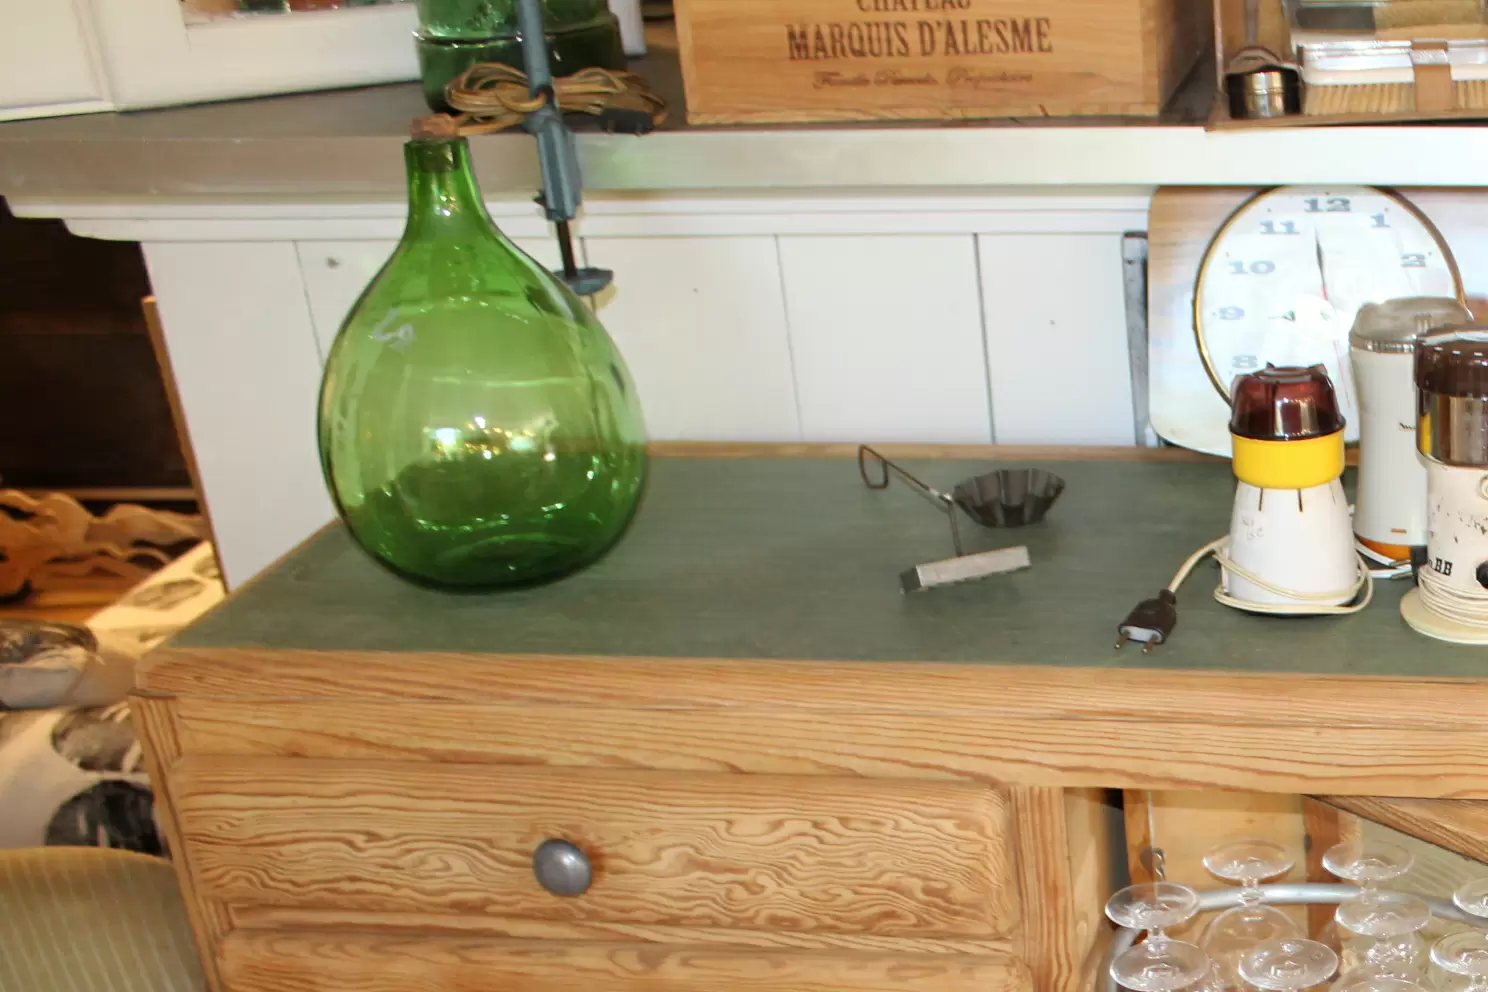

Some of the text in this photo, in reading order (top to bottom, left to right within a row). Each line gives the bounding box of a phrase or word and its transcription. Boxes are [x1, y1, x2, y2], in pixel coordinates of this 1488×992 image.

[785, 17, 1054, 61] MARQUIS D'ALESME
[1304, 197, 1352, 213] 12
[1260, 220, 1300, 235] 11
[1370, 213, 1391, 228] 1
[1229, 260, 1276, 275] 10
[1400, 253, 1427, 268] 2
[1219, 305, 1245, 321] 9
[1232, 354, 1258, 369] 8
